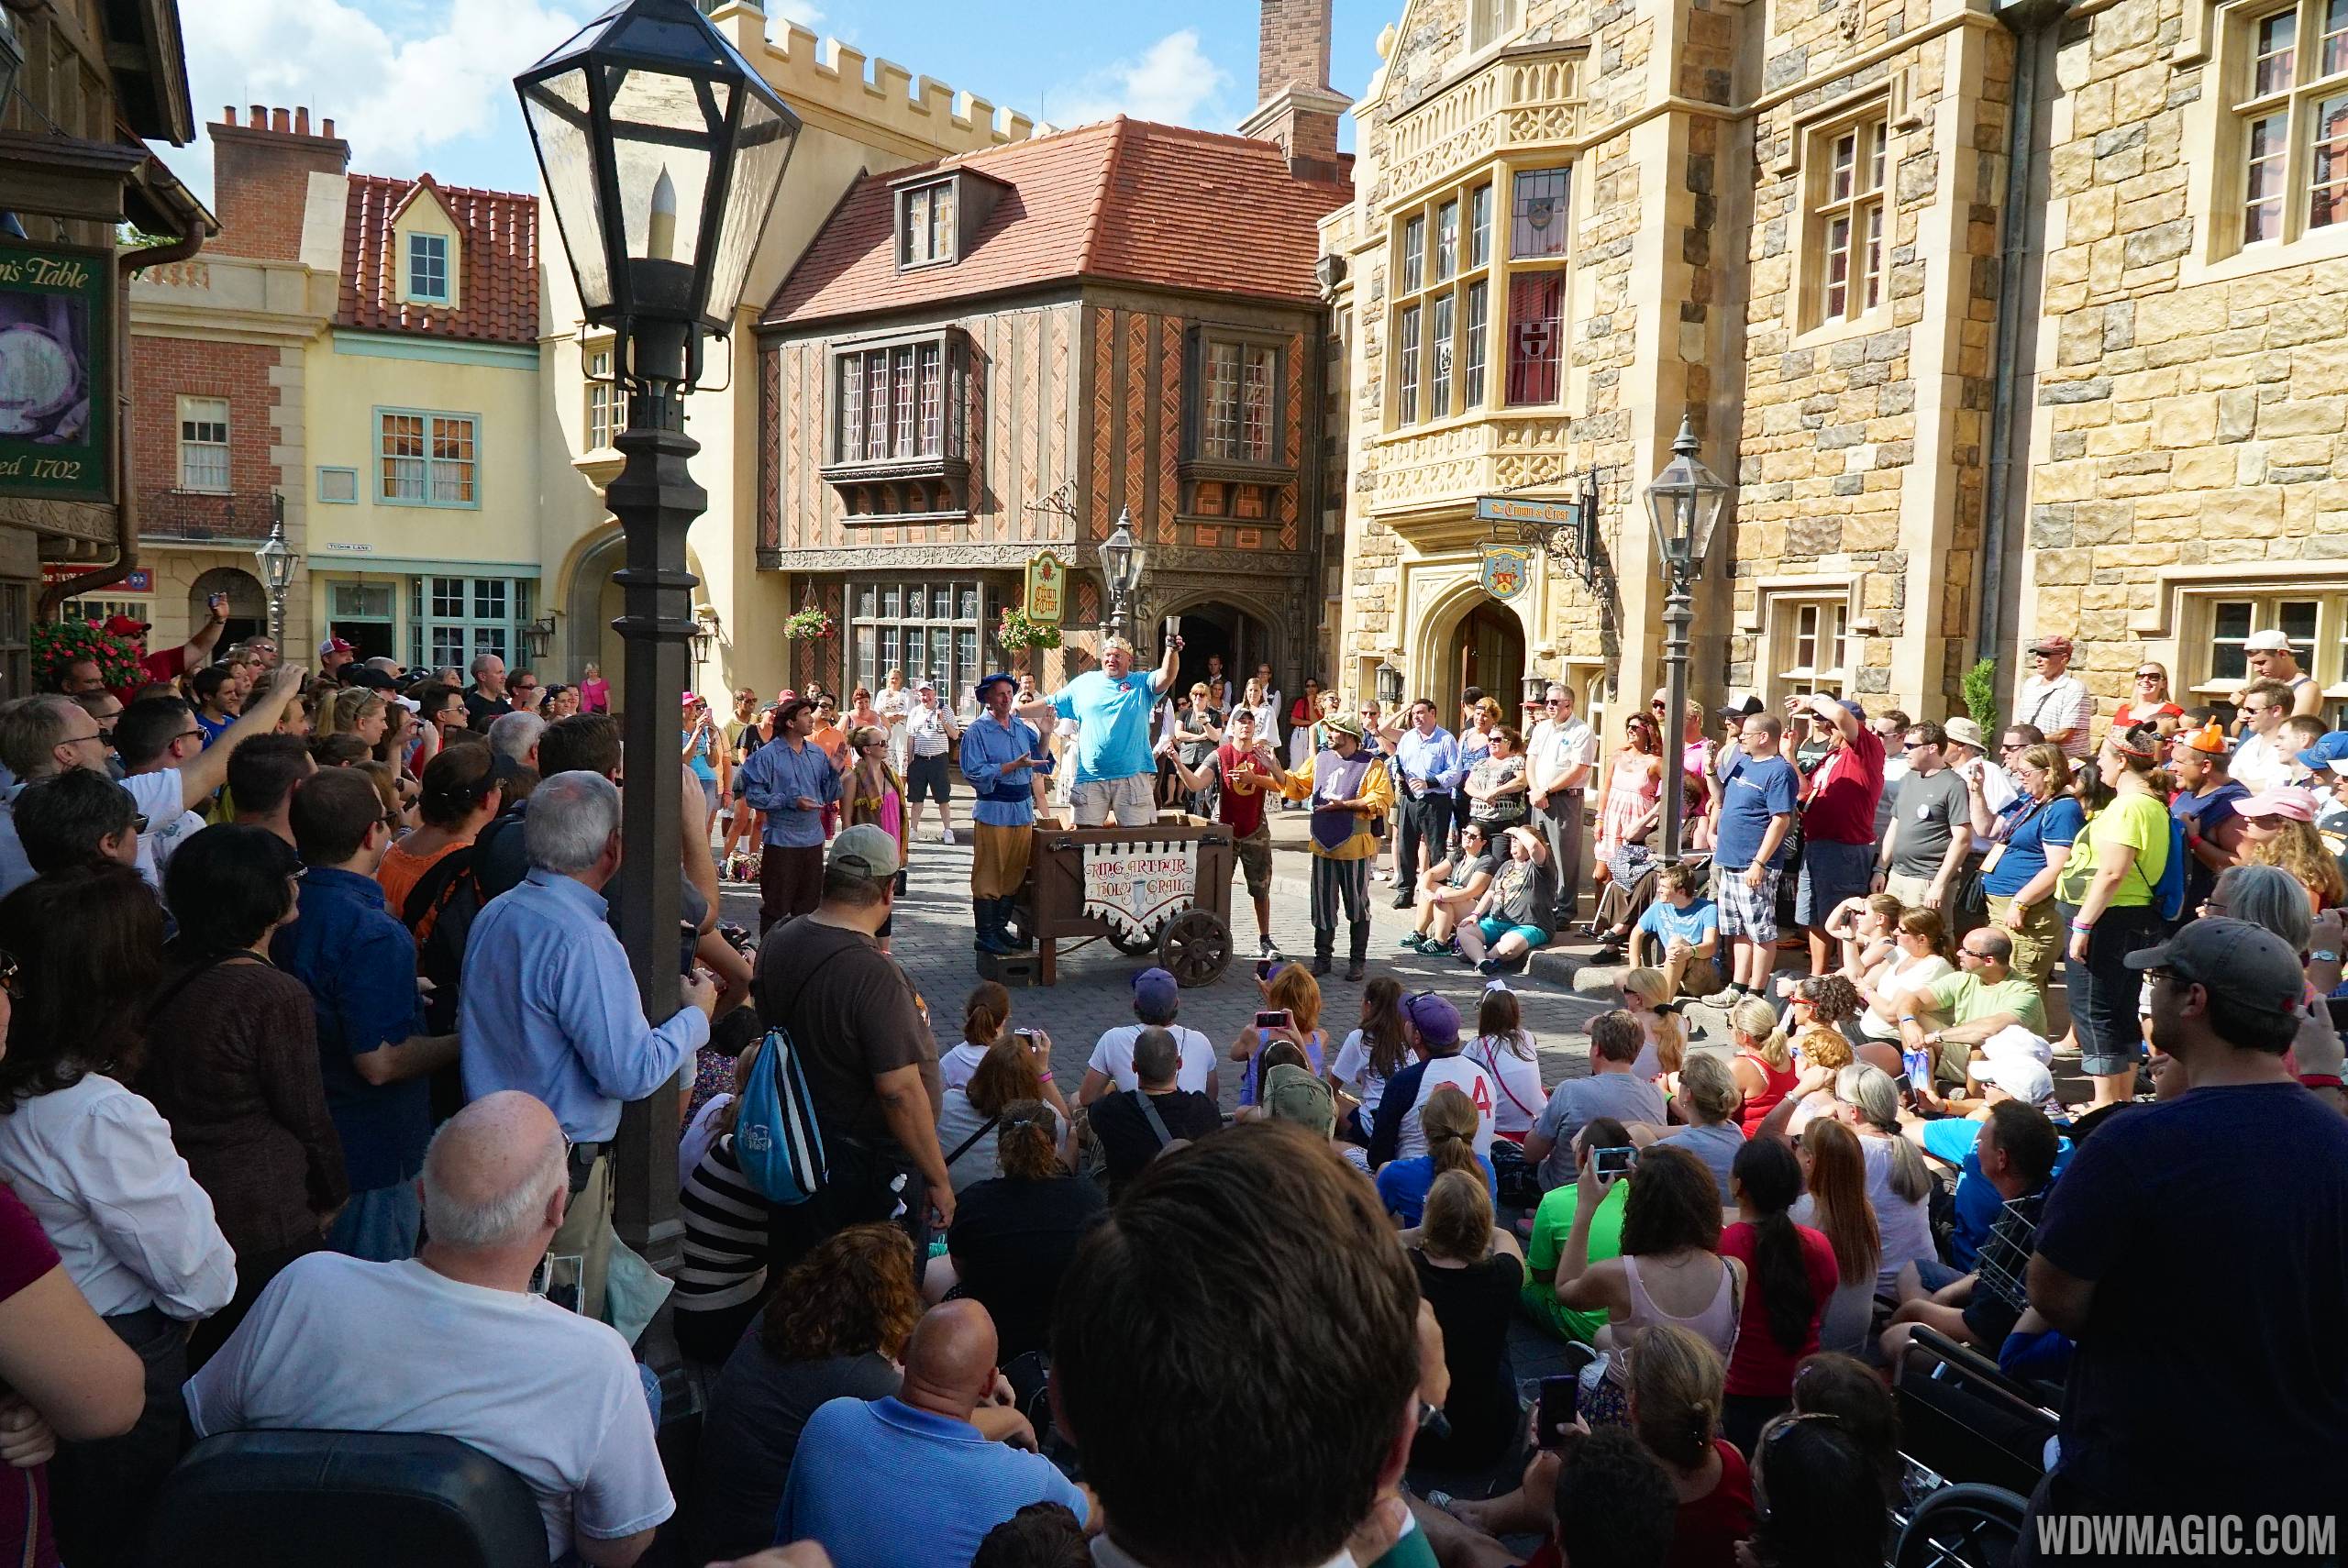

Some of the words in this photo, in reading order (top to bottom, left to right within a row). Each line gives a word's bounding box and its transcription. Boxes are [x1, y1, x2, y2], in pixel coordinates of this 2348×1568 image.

[26, 257, 89, 289] Table
[29, 458, 81, 480] 1702
[1504, 502, 1534, 518] Crown
[1535, 508, 1542, 517] &
[1545, 505, 1569, 520] Crest
[1035, 587, 1057, 602] Crown
[1091, 881, 1132, 901] HOLY
[1146, 879, 1191, 900] GRAIL
